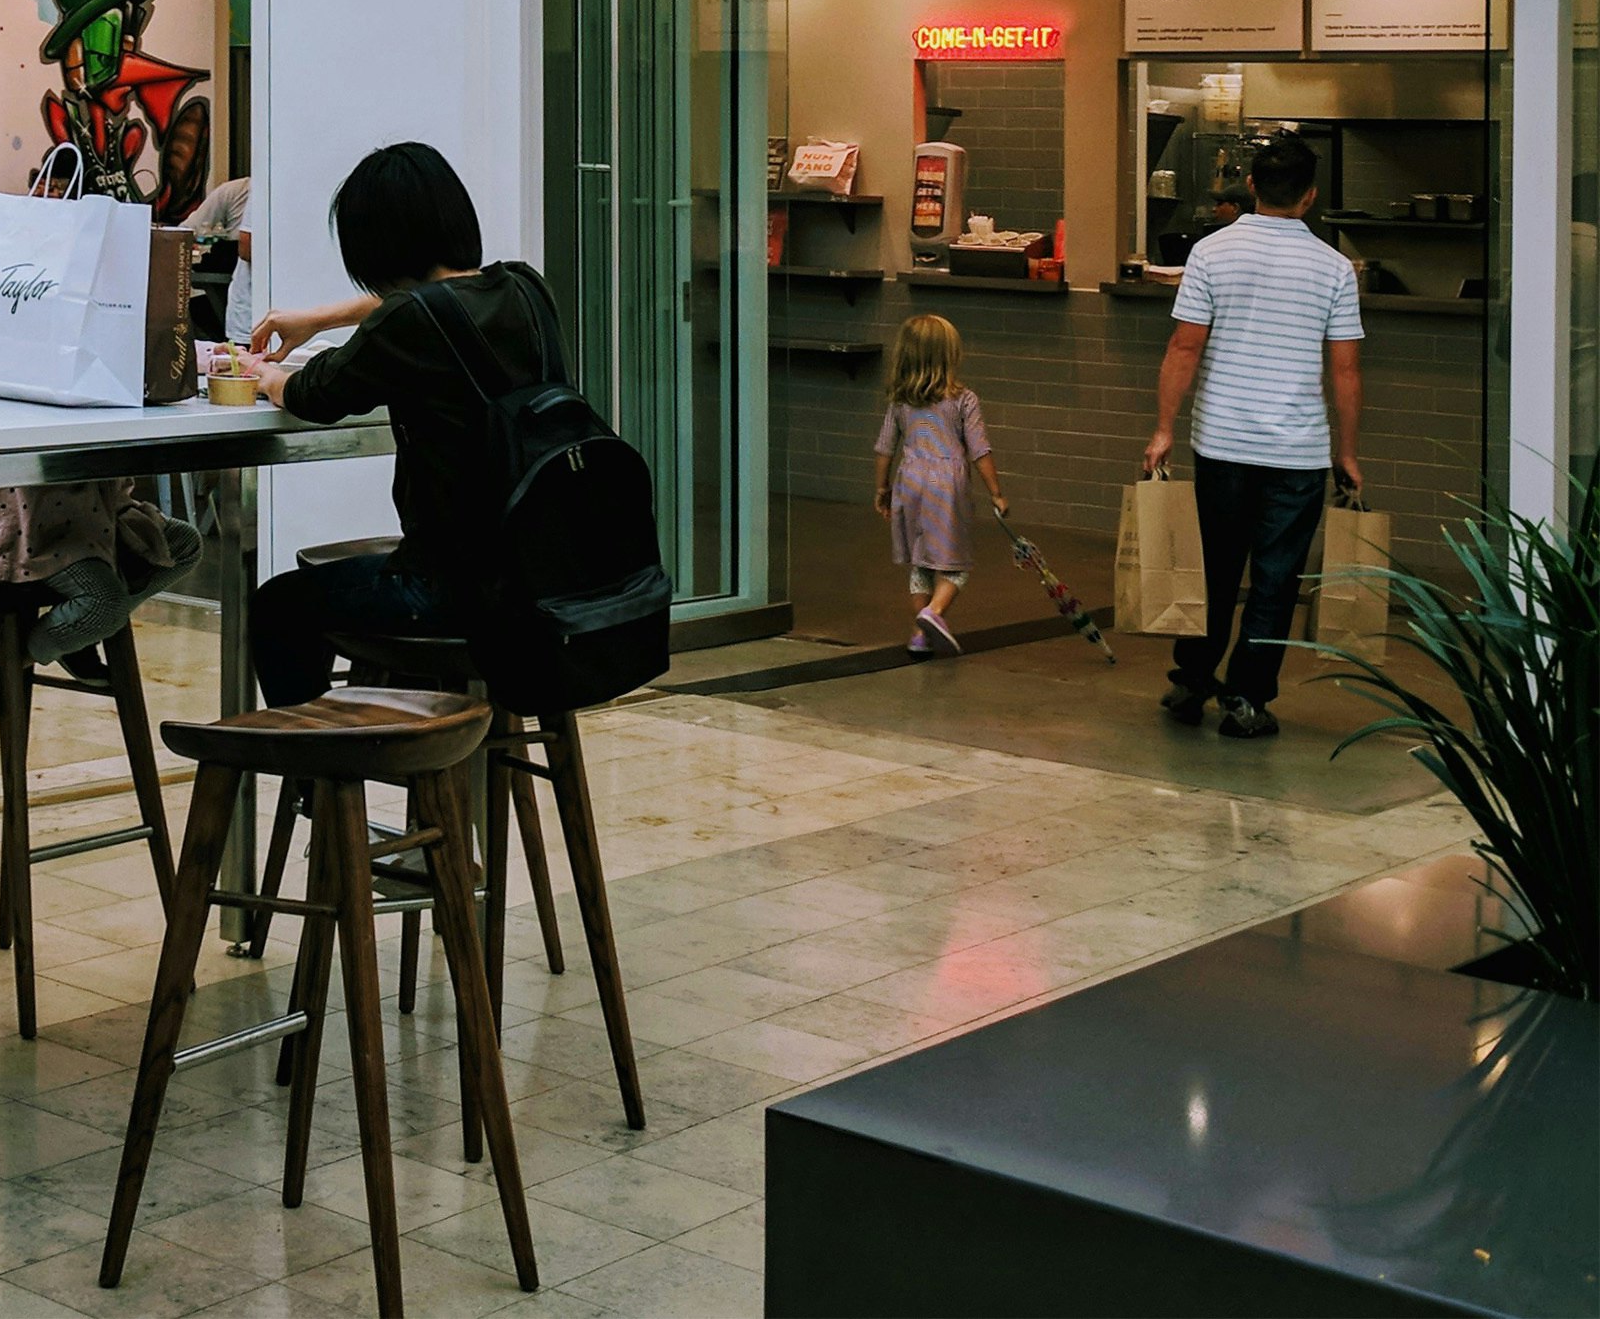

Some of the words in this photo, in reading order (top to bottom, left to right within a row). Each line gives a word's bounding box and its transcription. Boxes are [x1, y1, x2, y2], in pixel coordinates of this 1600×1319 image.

[917, 26, 1053, 49] COME-N-GET-IT
[796, 162, 833, 172] PANG
[803, 153, 834, 161] NUM
[177, 270, 186, 319] CHOCOLATE
[170, 335, 188, 381] Lindt
